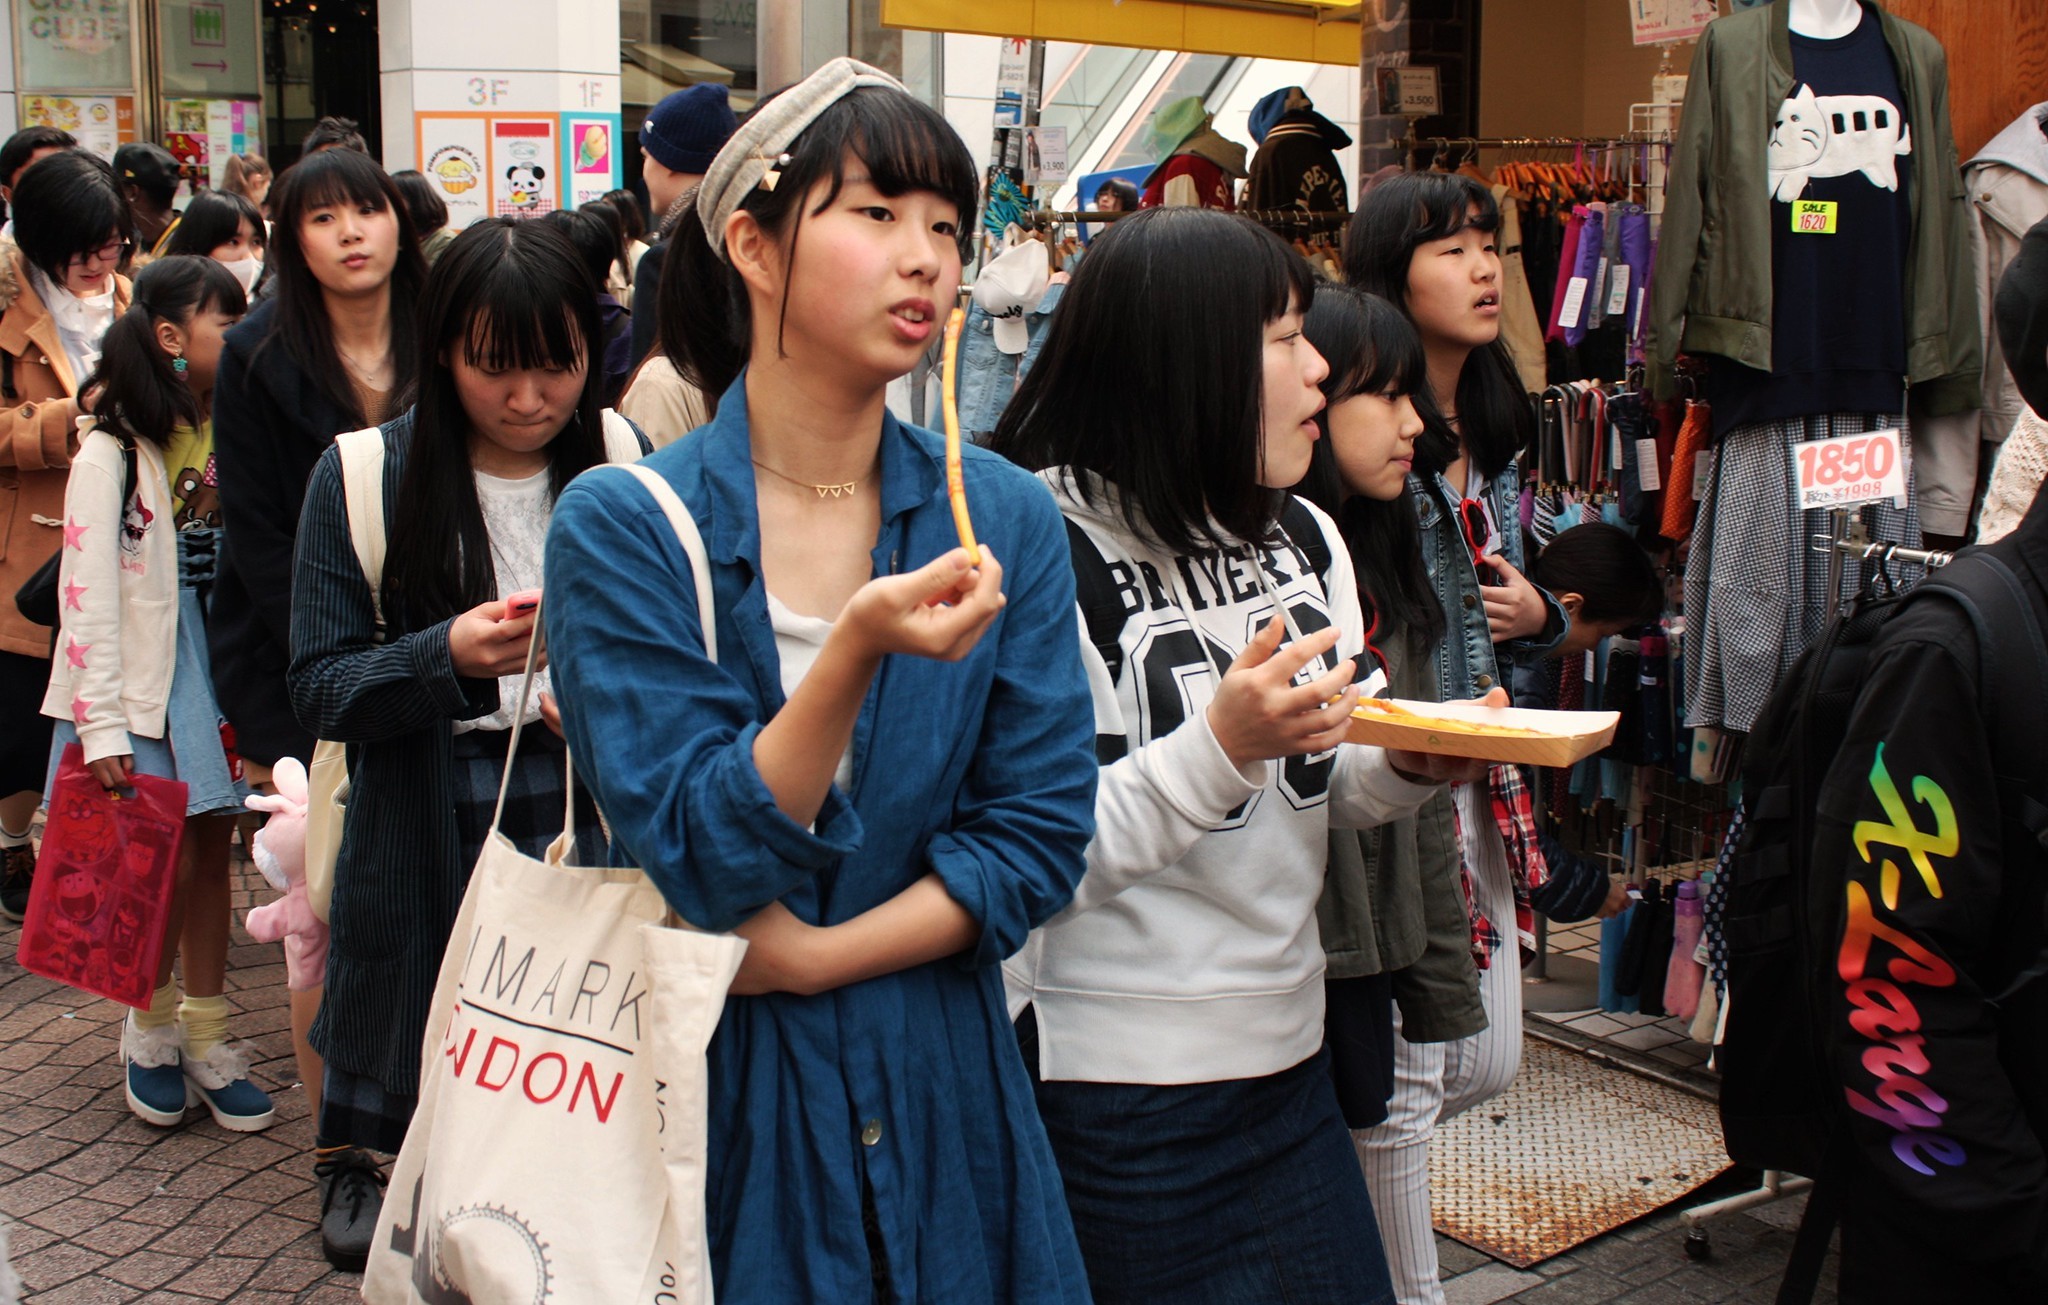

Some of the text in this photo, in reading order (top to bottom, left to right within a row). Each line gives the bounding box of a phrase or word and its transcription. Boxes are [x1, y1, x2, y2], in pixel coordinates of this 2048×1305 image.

[468, 77, 508, 105] 3F
[579, 79, 602, 107] 1F
[118, 109, 131, 120] 3F
[1802, 204, 1827, 213] SALE
[1800, 214, 1827, 230] 1620
[1799, 436, 1894, 488] 1850
[1832, 481, 1882, 500] ¥1998
[1838, 741, 1968, 1177] X-Large
